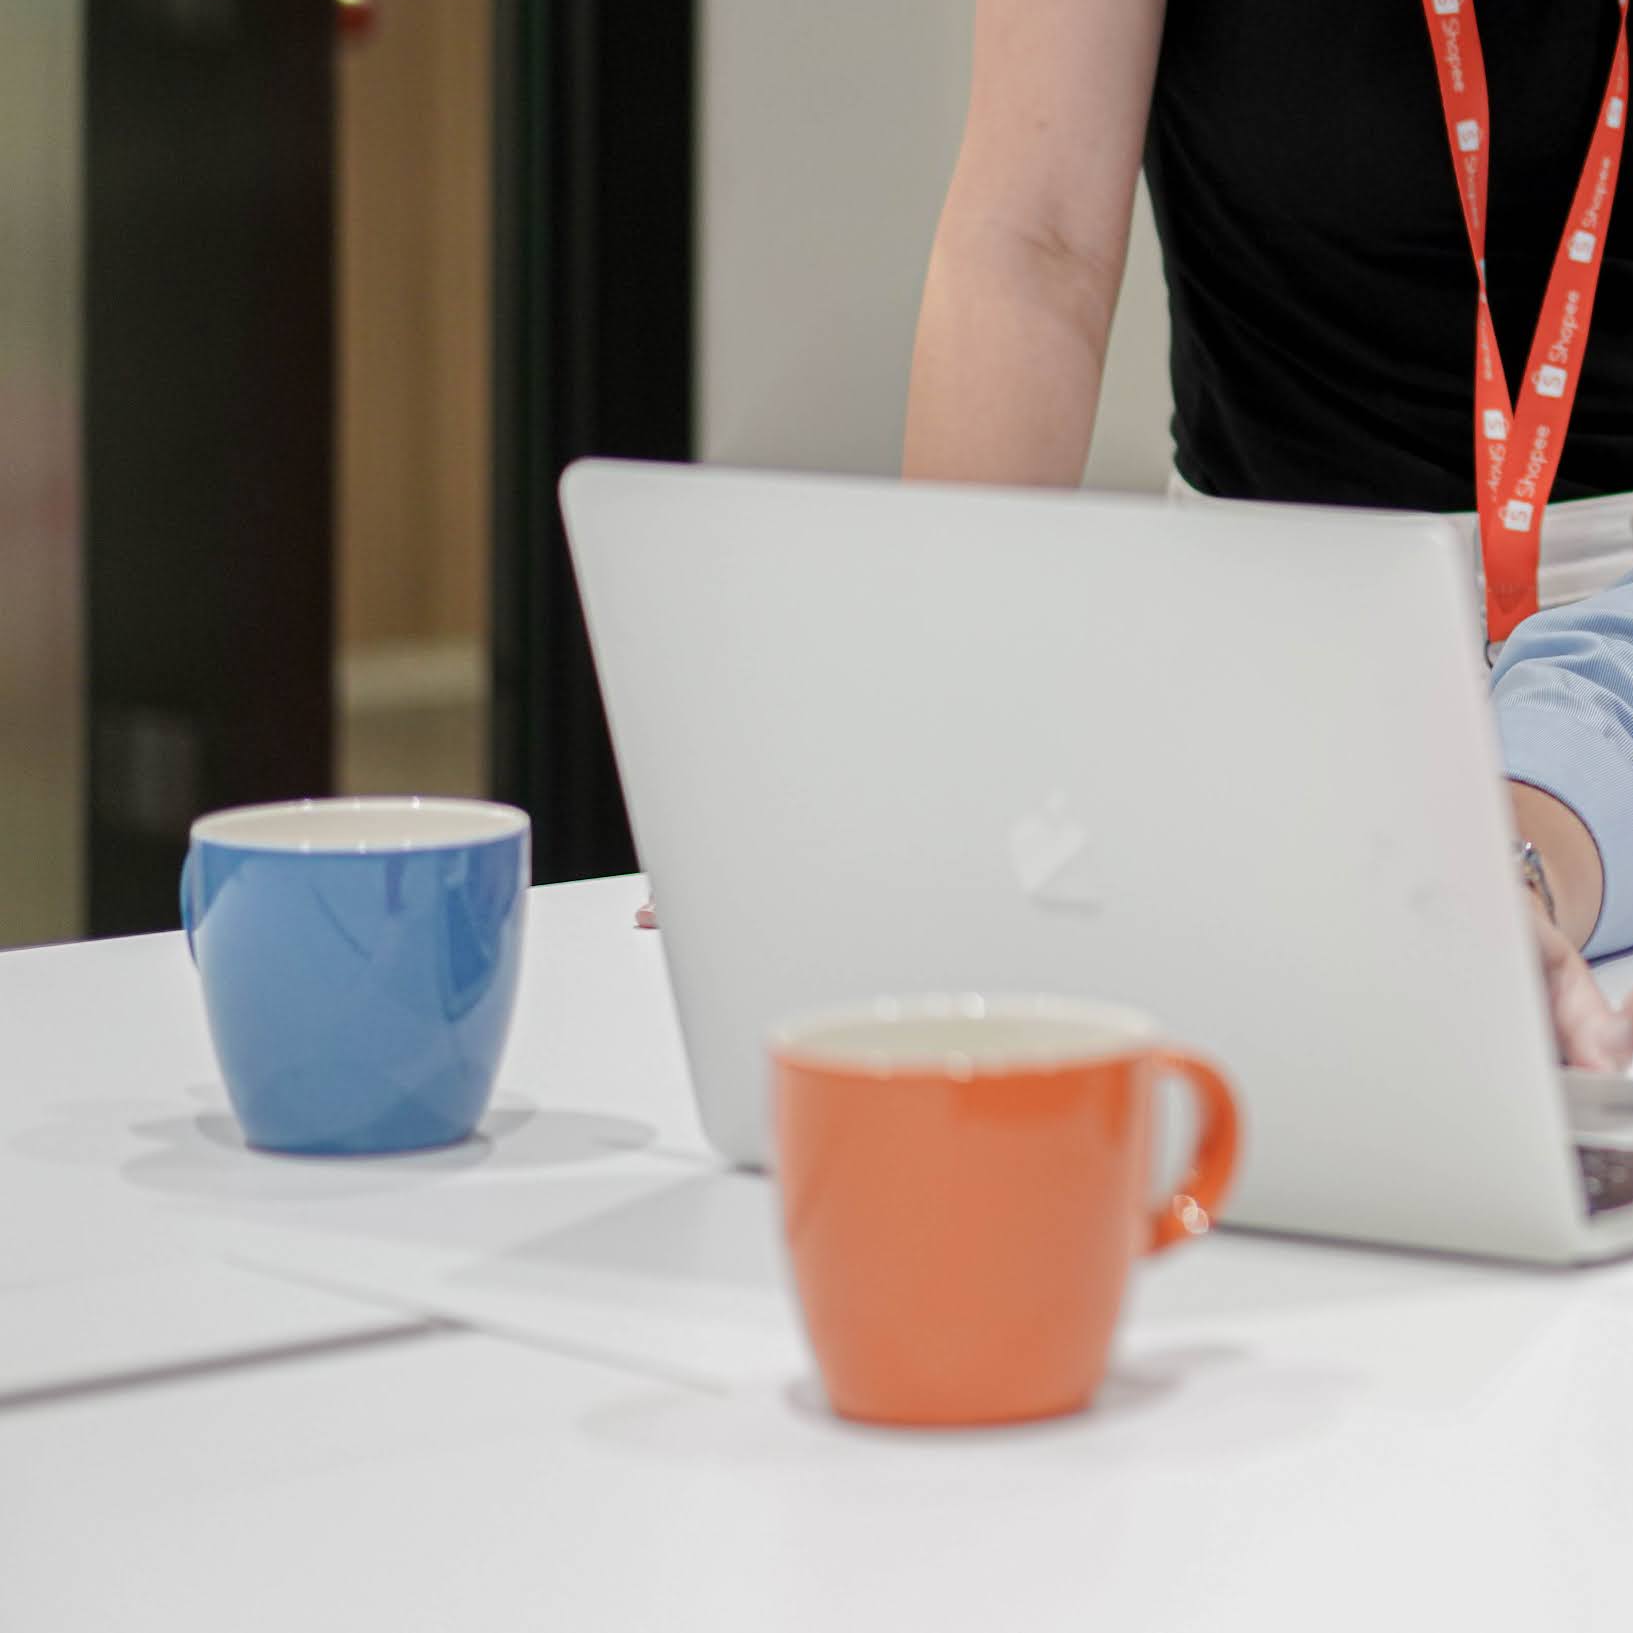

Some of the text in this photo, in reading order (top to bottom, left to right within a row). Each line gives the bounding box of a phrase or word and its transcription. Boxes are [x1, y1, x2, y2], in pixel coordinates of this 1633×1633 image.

[1441, 17, 1465, 92] Shopee
[1548, 291, 1579, 364] Shopee
[1516, 425, 1550, 499] Shopee
